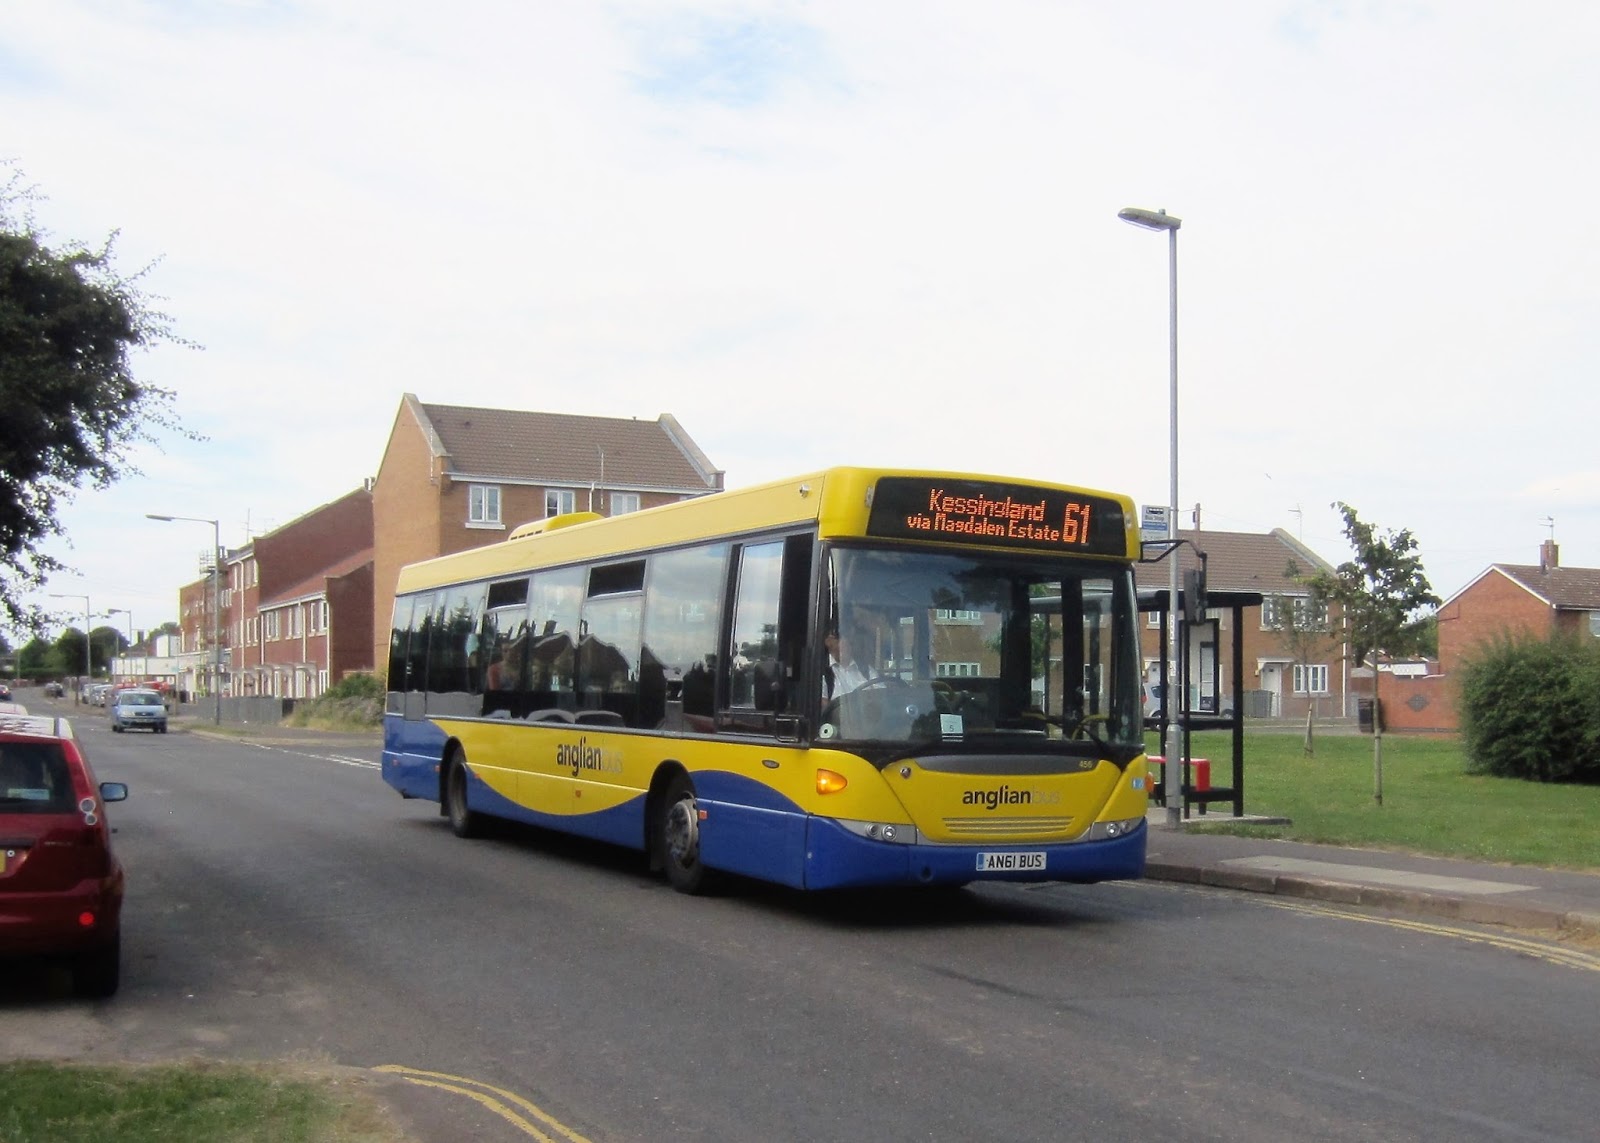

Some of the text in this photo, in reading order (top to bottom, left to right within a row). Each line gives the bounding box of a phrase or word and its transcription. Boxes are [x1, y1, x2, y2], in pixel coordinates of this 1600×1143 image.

[929, 488, 1046, 521] Kessingland
[907, 513, 1060, 541] via Magdalen Estate
[1062, 502, 1092, 544] 61
[987, 854, 1042, 868] AN61 BUS
